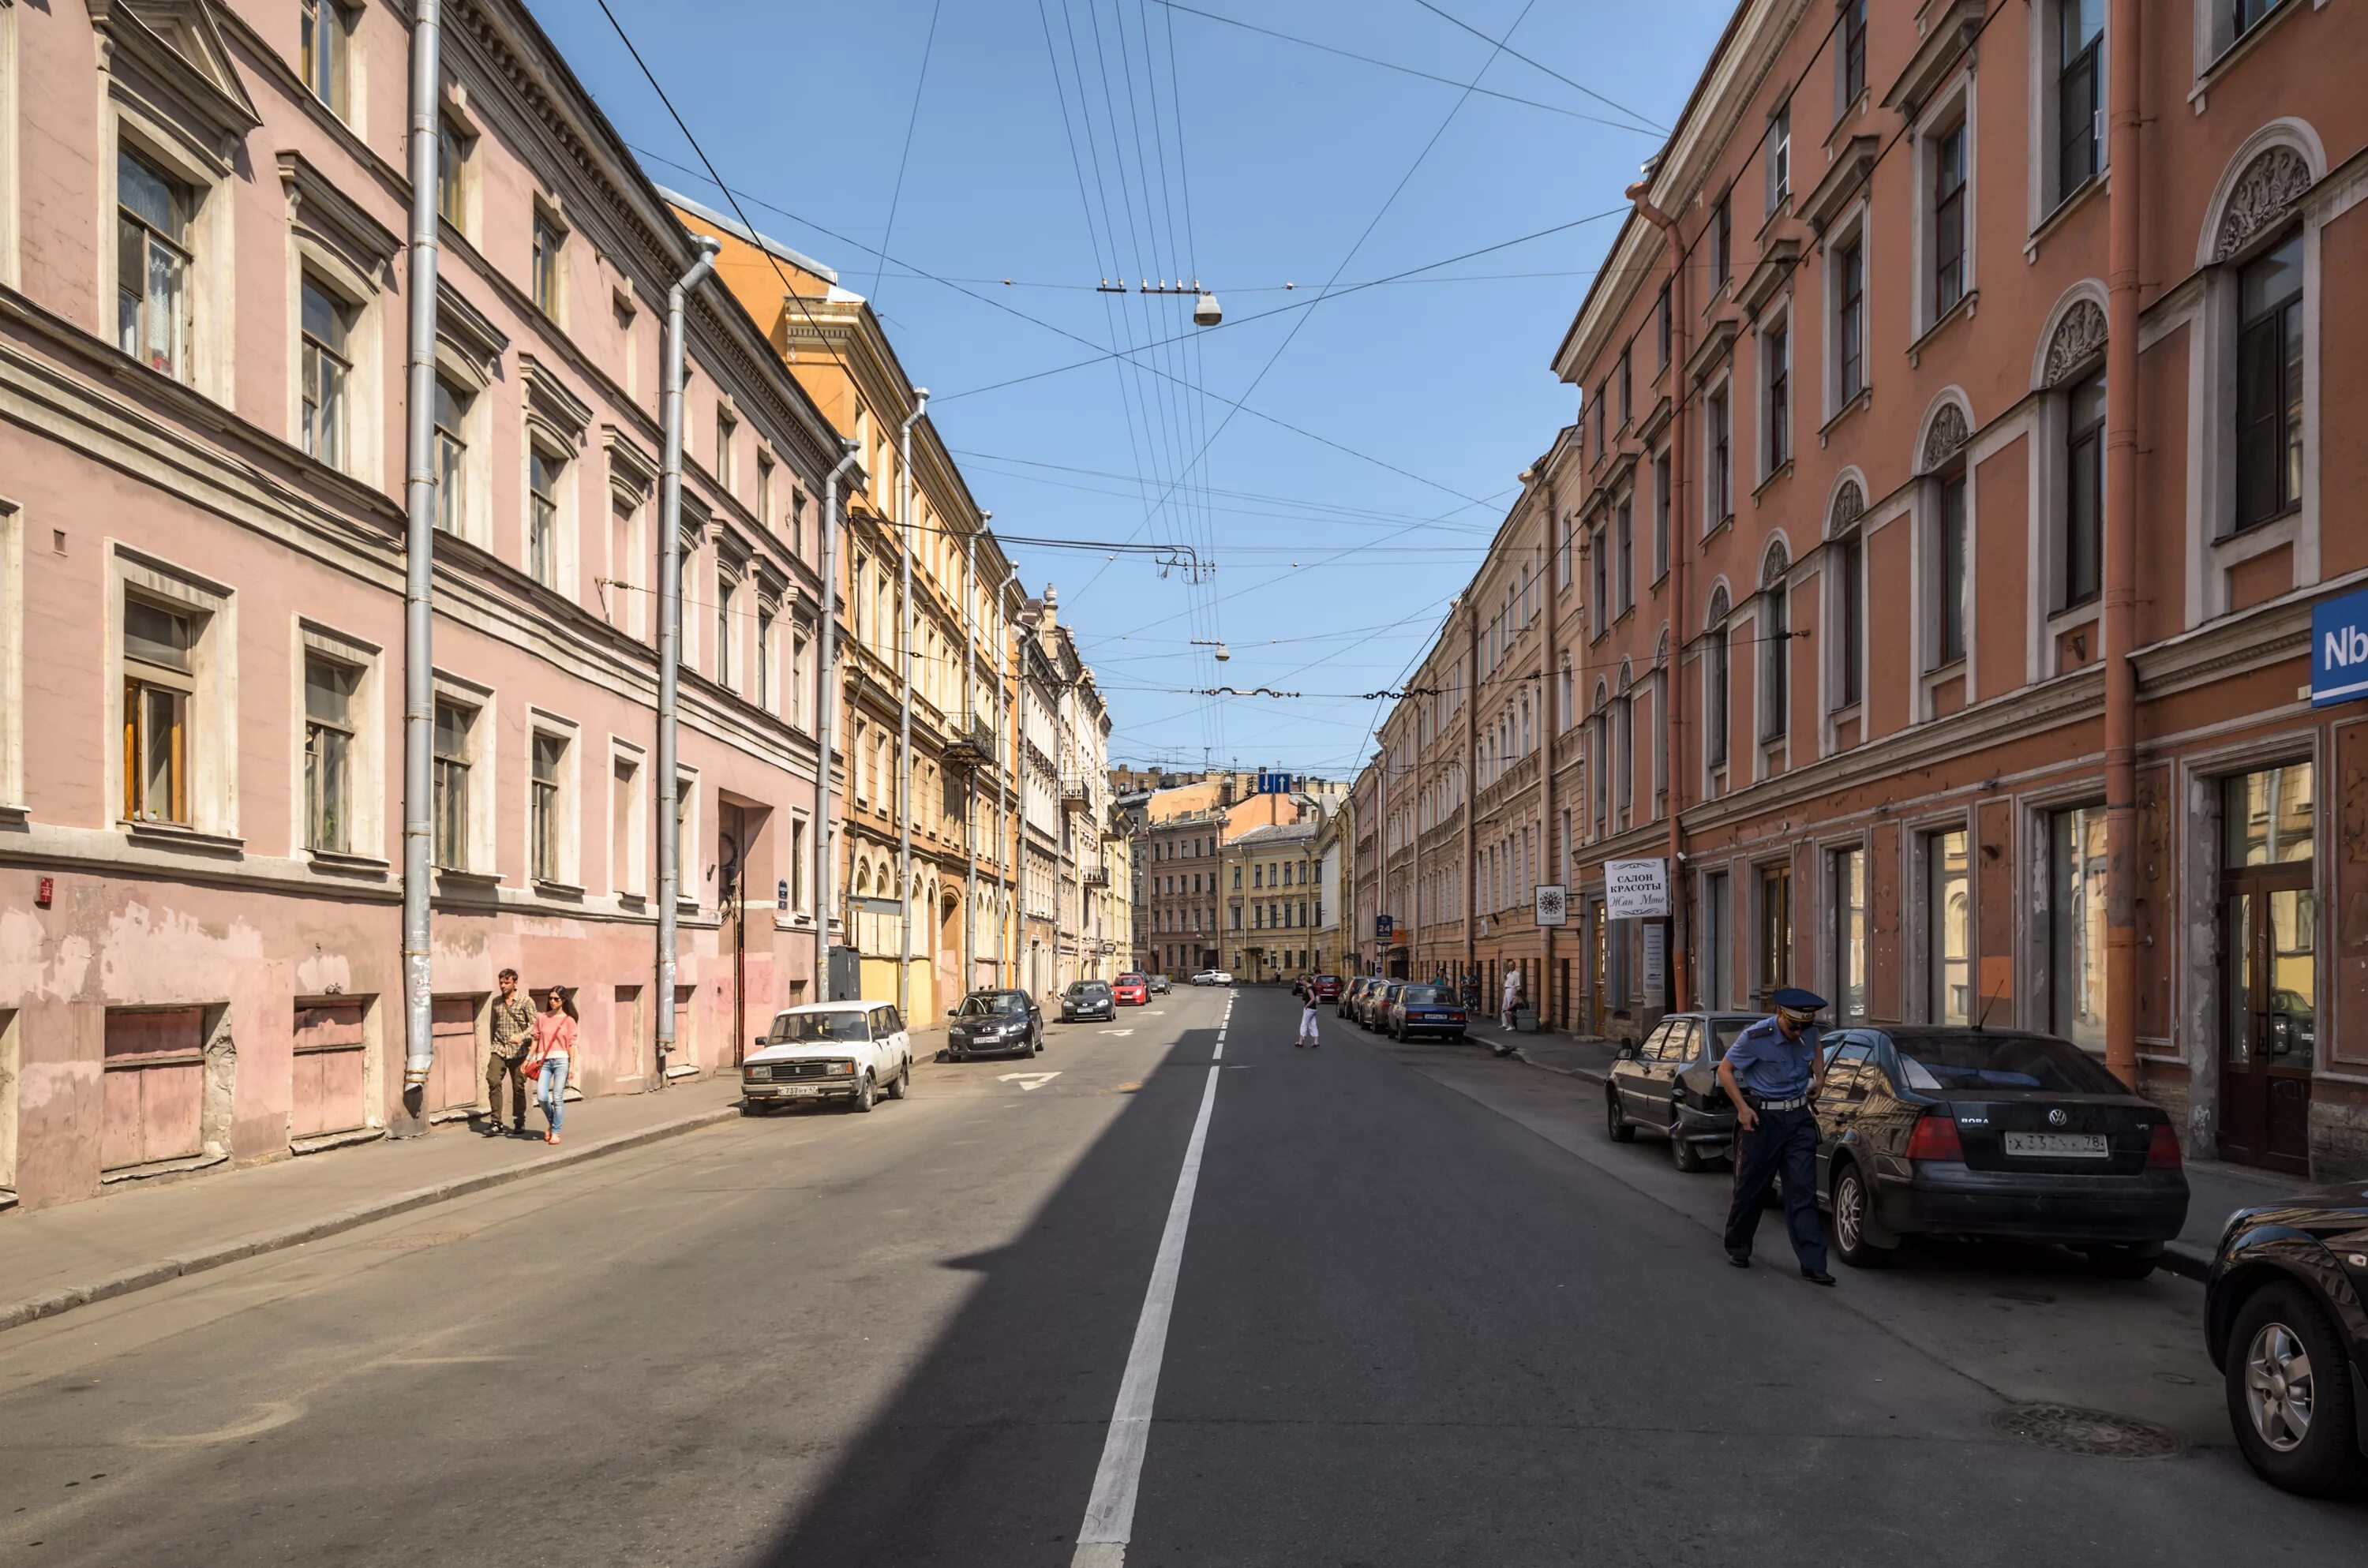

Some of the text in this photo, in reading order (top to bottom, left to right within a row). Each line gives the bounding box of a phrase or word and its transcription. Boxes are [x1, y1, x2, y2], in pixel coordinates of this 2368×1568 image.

[1617, 874, 1653, 883] САЛОН
[1610, 883, 1661, 893] КРАСОТЫ
[1609, 896, 1633, 907] Жан
